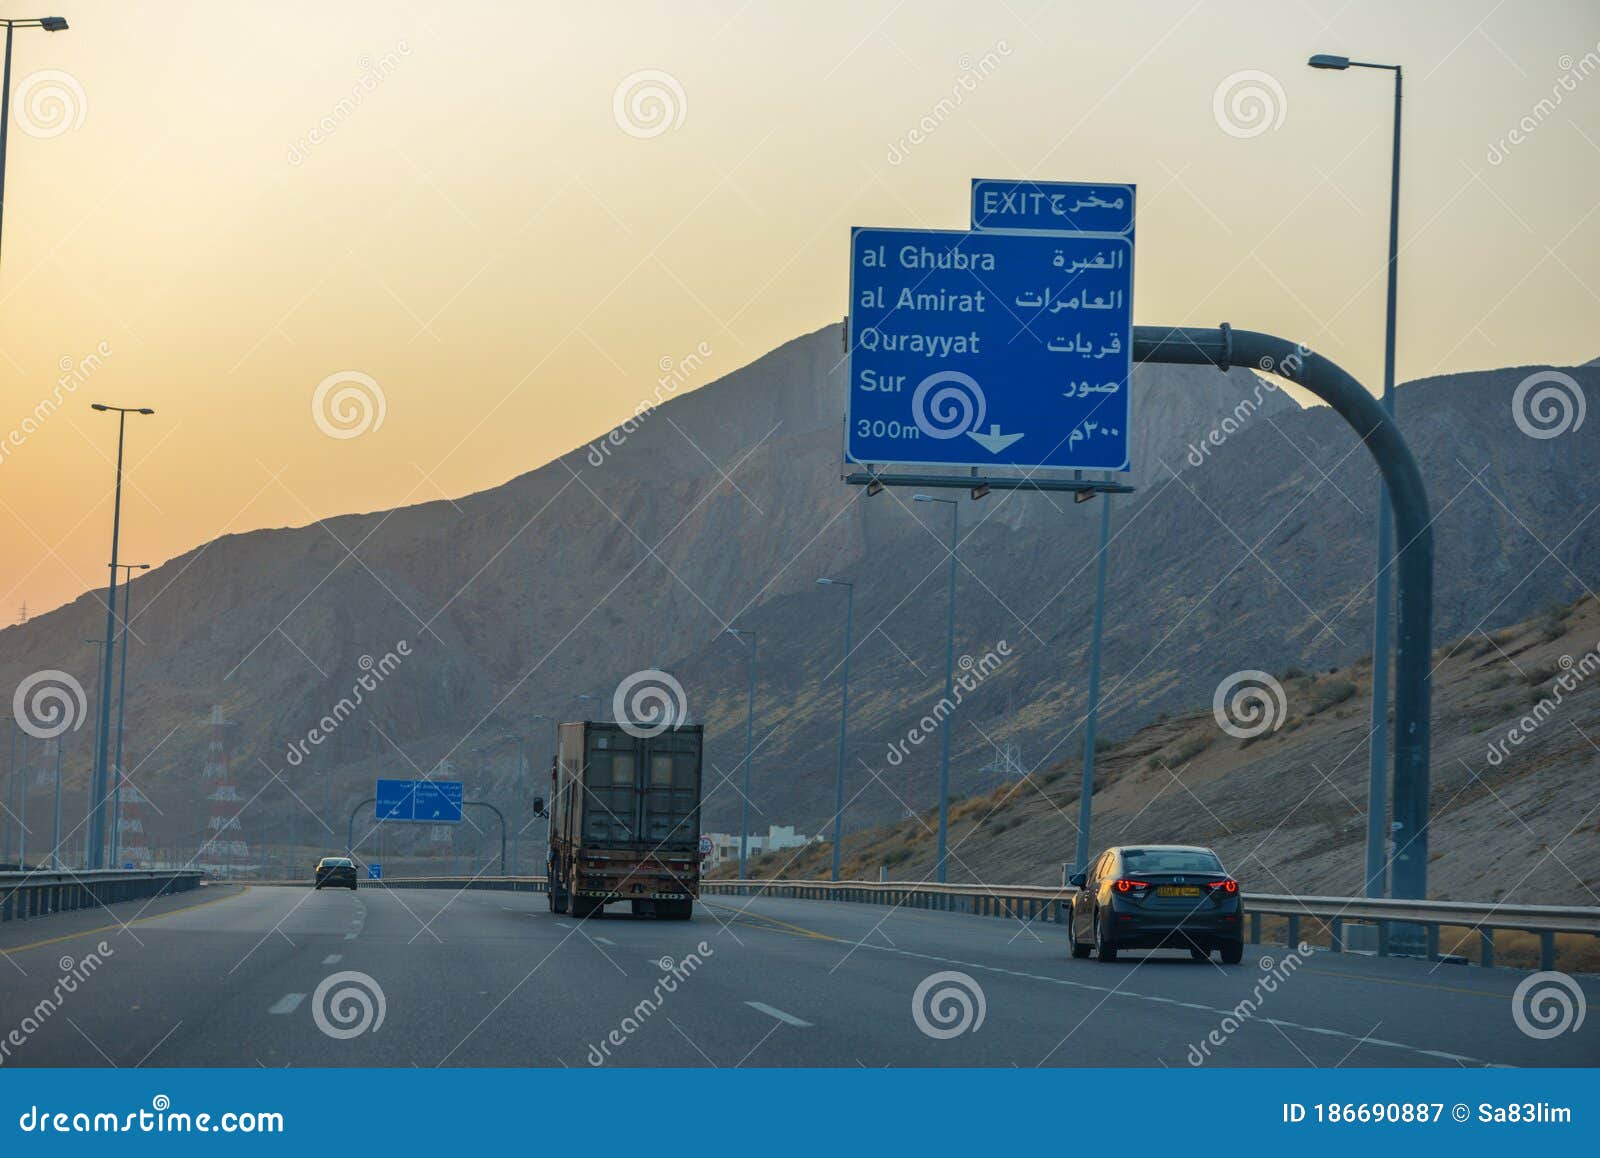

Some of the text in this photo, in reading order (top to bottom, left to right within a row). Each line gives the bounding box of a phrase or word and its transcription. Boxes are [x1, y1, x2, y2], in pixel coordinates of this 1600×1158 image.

[983, 191, 1046, 215] EXIT
[1050, 191, 1124, 216] مخرج
[862, 245, 995, 271] al Ghubra
[1052, 249, 1124, 274] الغبرة
[860, 286, 986, 313] al Amirat
[1015, 287, 1123, 314] العامرات
[859, 327, 980, 358] Qurayyat
[1047, 331, 1121, 359] قريات
[859, 369, 906, 393] Sur
[1062, 378, 1120, 398] صور
[857, 419, 920, 440] 300m
